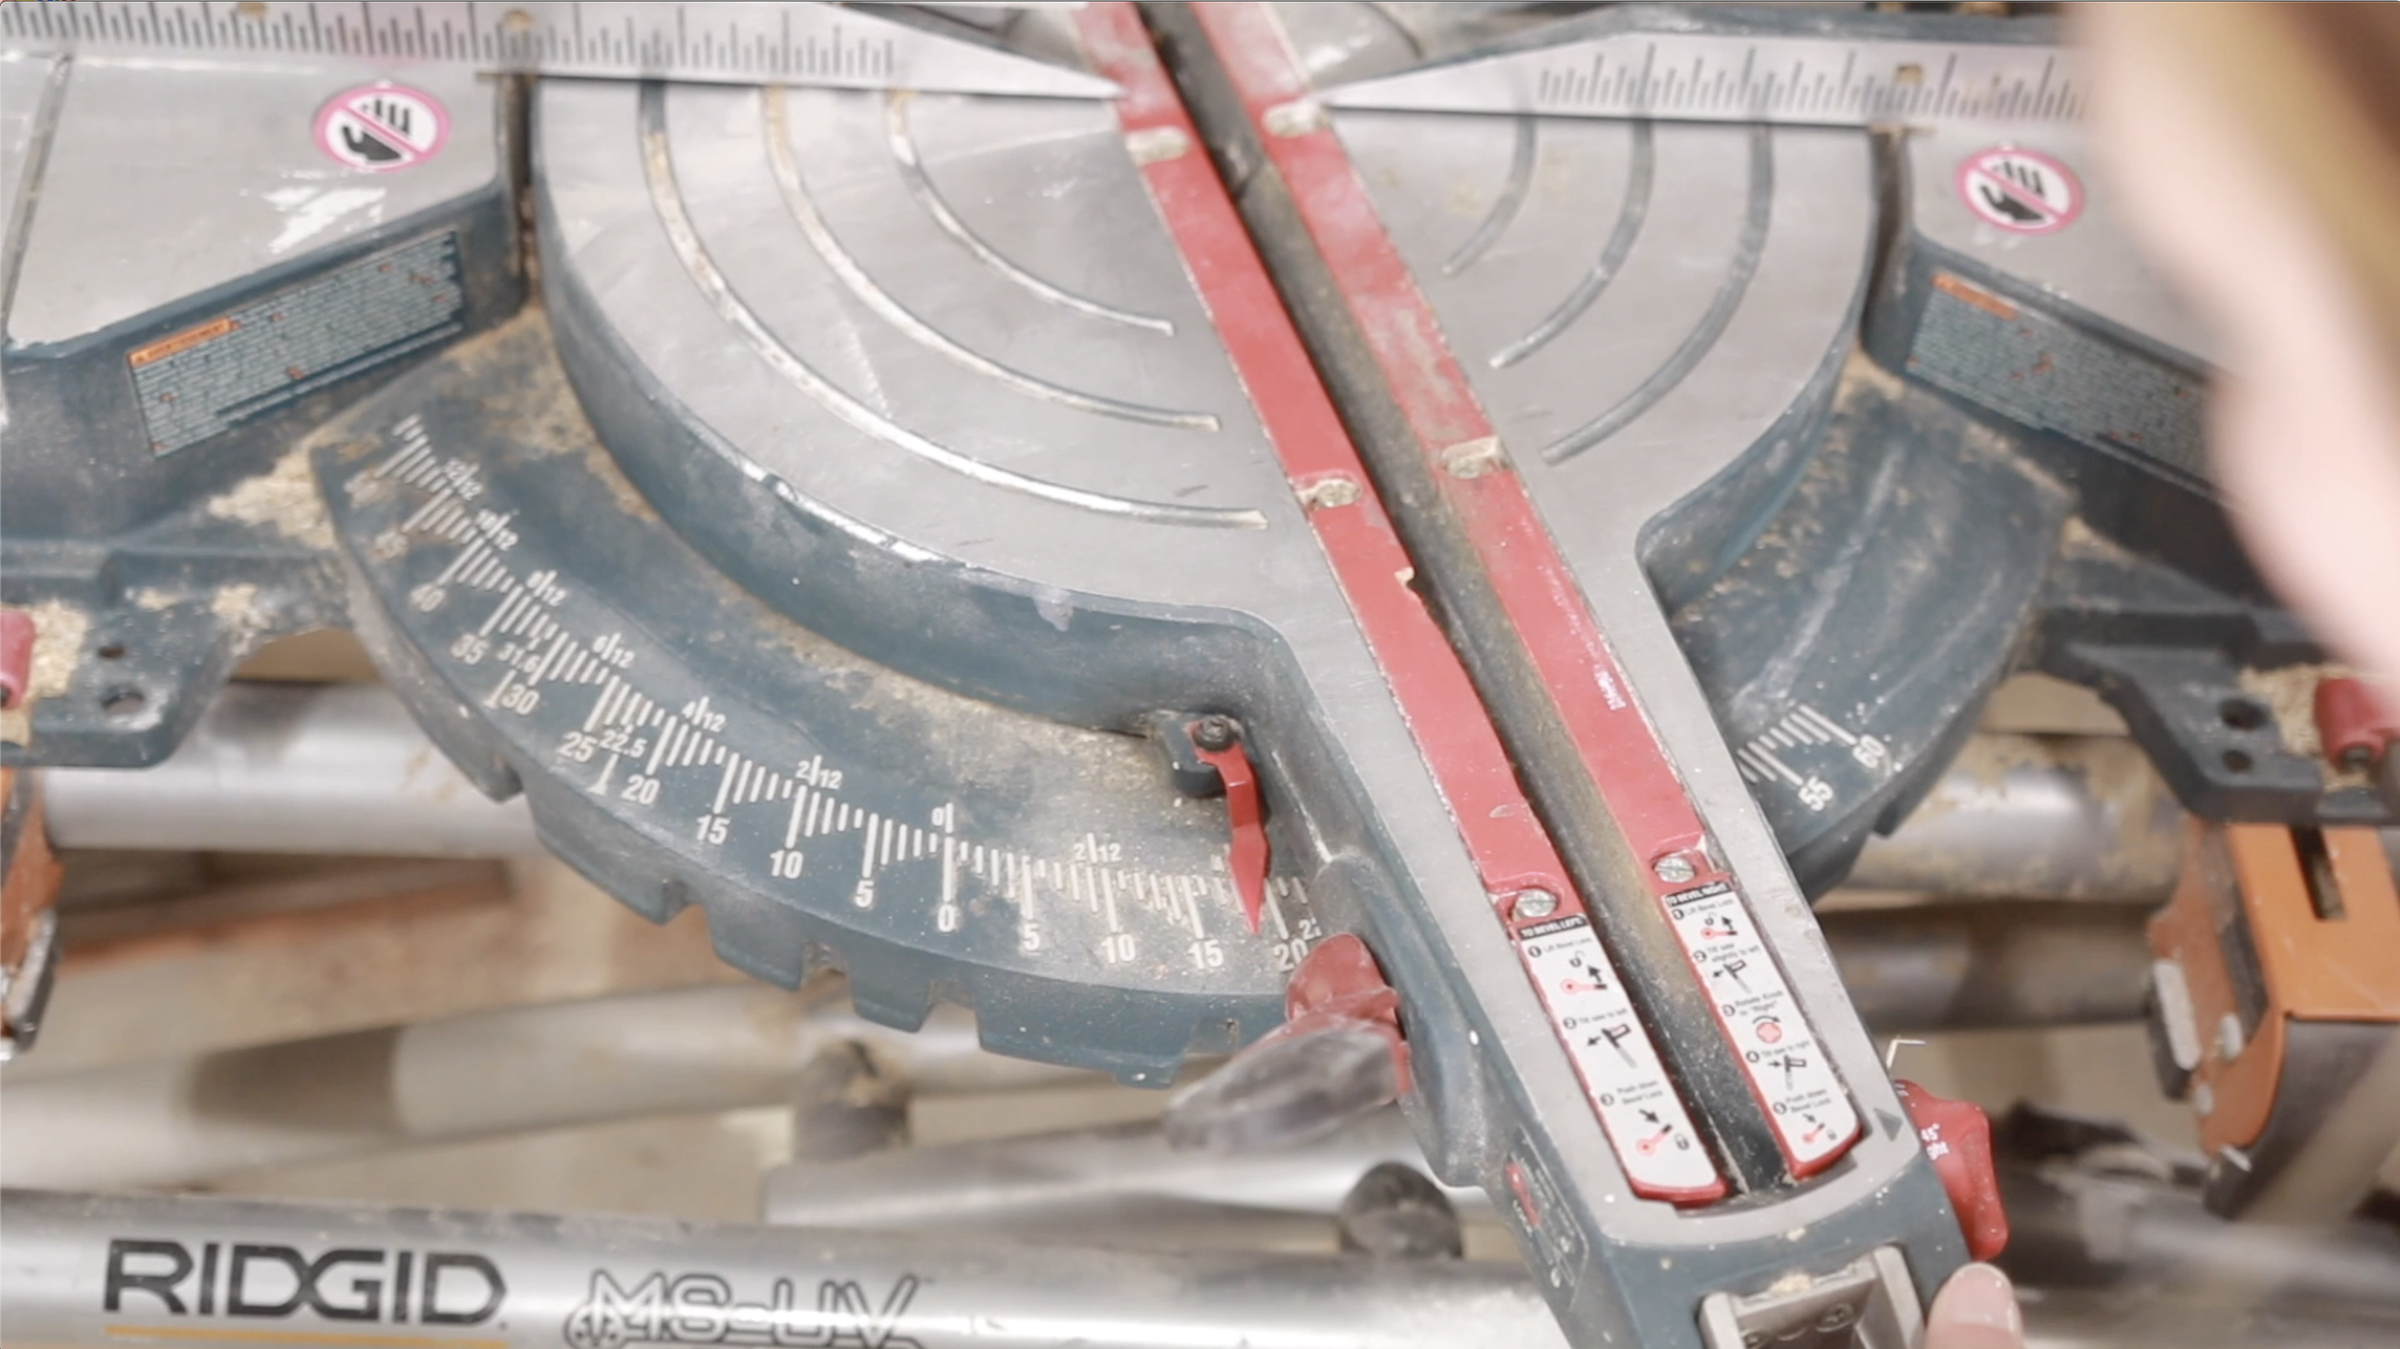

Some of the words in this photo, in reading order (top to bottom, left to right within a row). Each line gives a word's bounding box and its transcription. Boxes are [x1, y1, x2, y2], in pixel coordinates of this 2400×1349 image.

[411, 583, 446, 613] 40
[451, 633, 490, 665] 35
[502, 684, 541, 716] 30
[558, 731, 598, 763] 25
[599, 729, 648, 759] 22.5
[1852, 734, 1886, 769] 60
[621, 774, 661, 806] 20
[1798, 775, 1834, 812] 55
[696, 814, 732, 846] 15
[769, 849, 804, 880] 10
[854, 879, 875, 910] 5
[937, 904, 957, 934] 0
[1024, 923, 1041, 953] 5
[1101, 934, 1136, 964] 10
[1188, 938, 1224, 970] 15
[1273, 938, 1309, 972] 20
[103, 1238, 508, 1327] RIDGID
